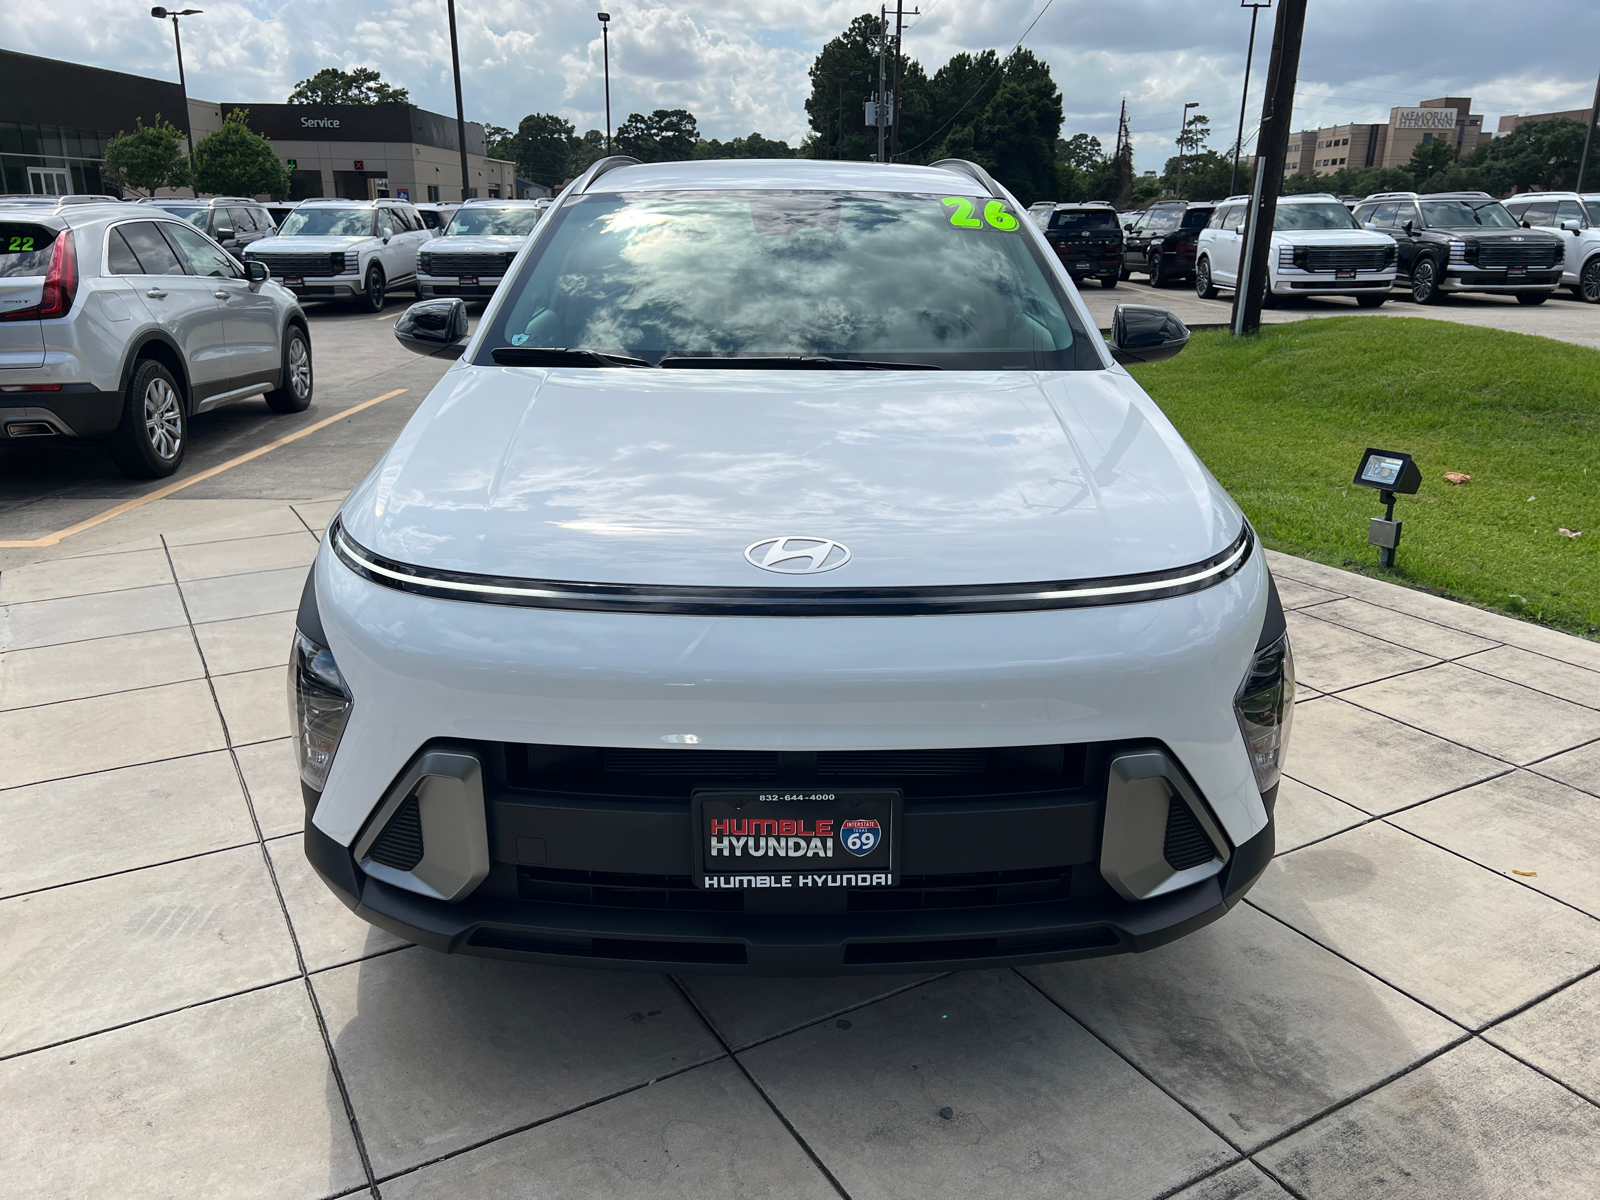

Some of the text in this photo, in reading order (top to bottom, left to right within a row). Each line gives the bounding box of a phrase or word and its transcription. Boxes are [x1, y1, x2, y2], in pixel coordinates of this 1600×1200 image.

[300, 116, 340, 128] Service
[1400, 111, 1454, 120] MEMORIAL
[1399, 119, 1453, 128] HERMANN
[941, 197, 1020, 232] 26
[9, 236, 34, 251] 22
[710, 818, 834, 836] HUMBLE
[710, 836, 834, 858] HYUNDAI
[847, 832, 875, 850] 69
[704, 873, 892, 888] HUMBLE HYUNDAI
